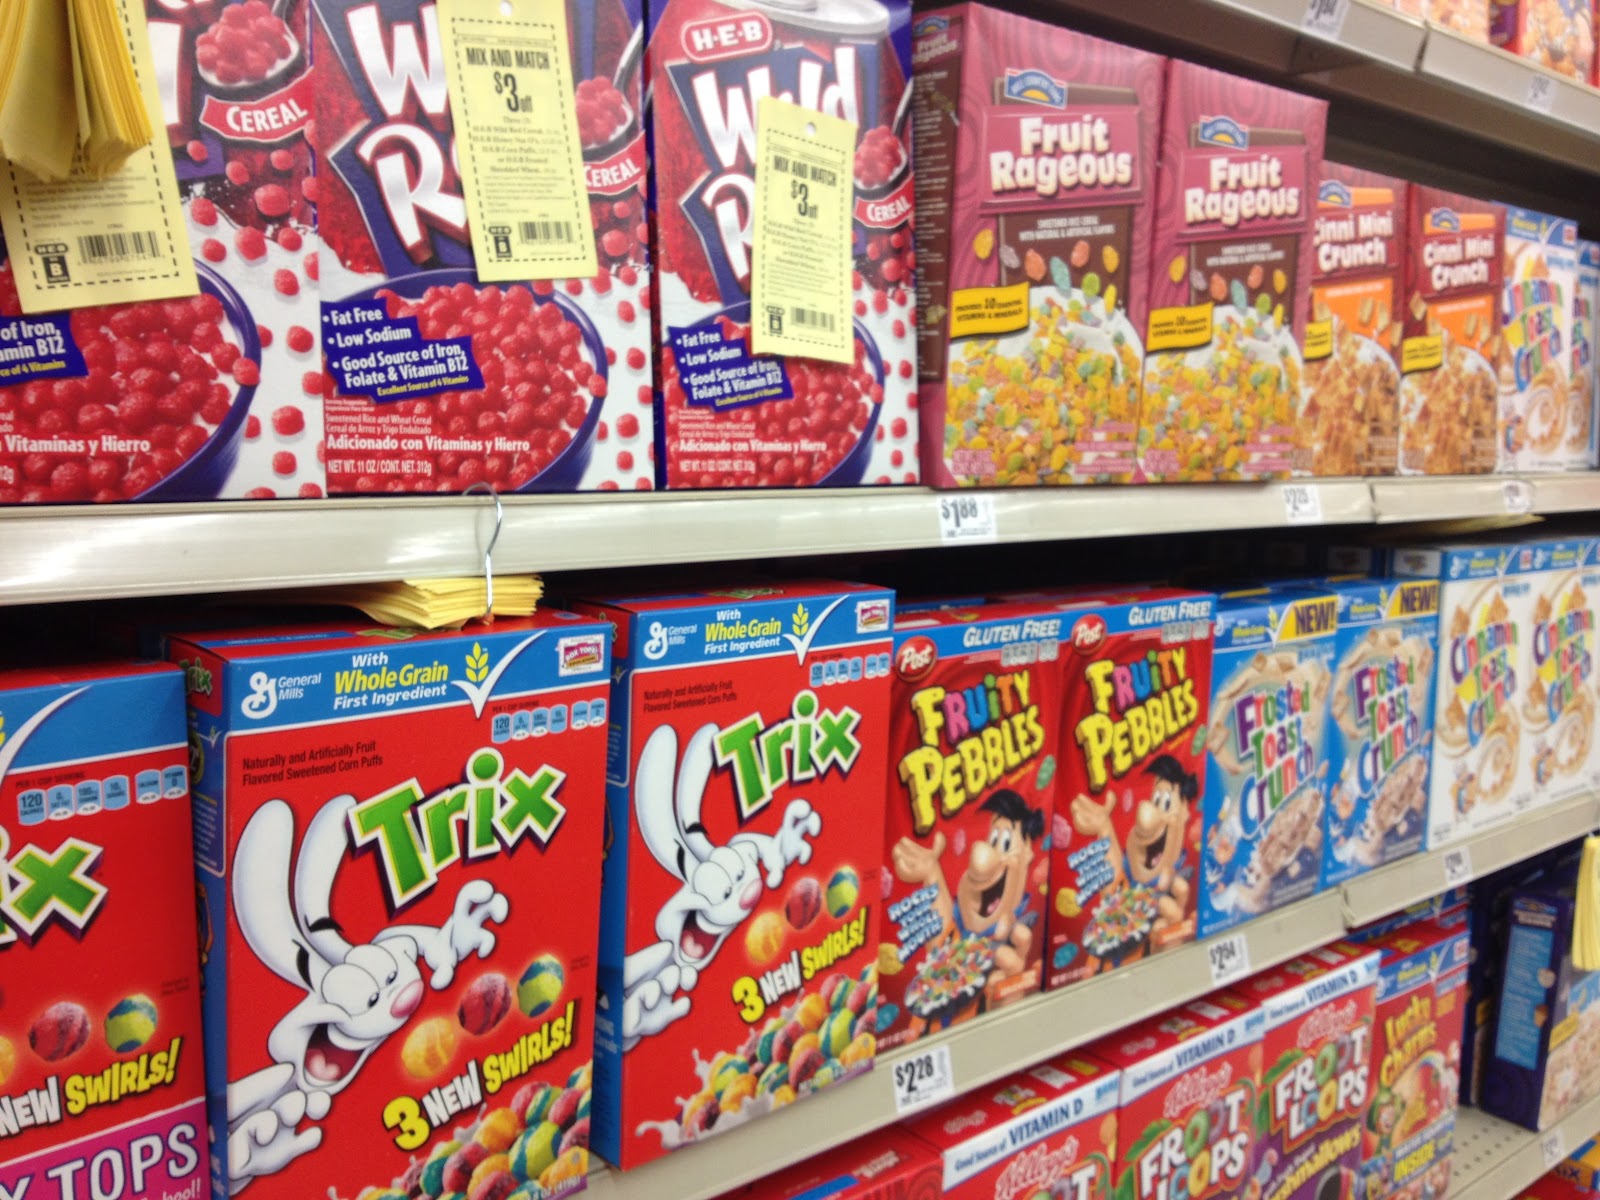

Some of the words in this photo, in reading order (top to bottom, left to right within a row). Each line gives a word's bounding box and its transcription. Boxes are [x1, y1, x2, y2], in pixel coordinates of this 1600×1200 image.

[466, 47, 488, 65] MIX
[490, 48, 512, 67] AND
[515, 49, 550, 70] MATCH
[493, 70, 520, 112] $3
[226, 98, 308, 133] CEREAL
[692, 46, 860, 168] Wld
[1019, 114, 1110, 156] Fruit
[583, 158, 641, 187] CEREAL
[774, 155, 788, 172] MIX
[792, 161, 807, 179] AND
[810, 165, 836, 187] MATCH
[989, 151, 1133, 196] Rageous
[1210, 153, 1282, 192] Fruit
[1184, 187, 1300, 226] Rageous
[1358, 210, 1394, 238] Mini
[1317, 238, 1387, 273] Crunch
[1423, 241, 1464, 268] Cinni
[1465, 234, 1496, 259] Mini
[1431, 258, 1489, 291] Crunch
[1, 322, 18, 341] of
[20, 321, 62, 338] Iron,
[331, 310, 352, 326] Fat
[353, 307, 383, 321] Free
[36, 336, 66, 357] B12
[336, 332, 364, 348] Low
[365, 325, 412, 344] Sodium
[682, 334, 699, 347] Fat
[698, 331, 721, 345] Free
[341, 352, 376, 371] Good
[377, 350, 420, 367] Source
[421, 344, 434, 360] of
[435, 343, 466, 359] Iron,
[686, 353, 707, 366] Low
[707, 346, 742, 362] Sodium
[344, 371, 386, 388] Folate
[387, 366, 398, 381] &
[399, 360, 447, 380] Vitamin
[447, 356, 469, 373] B12
[326, 413, 361, 424] Sweetened
[362, 413, 376, 424] Rice
[377, 414, 389, 424] and
[412, 415, 432, 425] Cereal
[5, 434, 85, 453] Vitaminas
[88, 439, 99, 457] y
[101, 435, 151, 453] Hierro
[327, 434, 398, 450] Adicionado
[401, 438, 423, 450] con
[425, 436, 483, 451] Vitaminas
[484, 439, 493, 454] y
[495, 436, 531, 451] Hierro
[680, 439, 732, 452] Adicionado
[732, 441, 749, 452] con
[751, 439, 793, 452] Vitaminas
[328, 460, 343, 473] NET
[416, 461, 432, 476] 312g
[1128, 603, 1175, 626] GLUTEN
[1176, 600, 1212, 619] FREE!
[1400, 583, 1438, 613] NEW!
[668, 624, 698, 636] General
[705, 621, 746, 642] Whole
[747, 617, 782, 637] Grain
[716, 609, 741, 621] With
[1293, 600, 1336, 636] NEW!
[668, 635, 686, 645] Mills
[704, 642, 727, 655] First
[729, 637, 781, 653] Ingredient
[963, 621, 1021, 648] GLUTEN
[1021, 617, 1062, 640] FREE!
[1074, 619, 1103, 647] Post
[352, 652, 389, 668] With
[899, 645, 933, 673] Post
[278, 672, 322, 688] General
[335, 665, 399, 695] Whole
[400, 661, 449, 686] Grain
[1085, 646, 1186, 714] FRUITY
[278, 687, 304, 701] Mills
[333, 692, 368, 711] First
[371, 683, 447, 706] Ingredient
[911, 669, 1030, 748] FRUITY
[495, 717, 510, 728] 120
[1234, 679, 1310, 758] Frosted
[1074, 678, 1199, 793] PEBBLES
[243, 754, 285, 770] Naturally
[289, 752, 306, 764] and
[308, 743, 354, 762] Artificially
[356, 740, 376, 754] Fruit
[243, 769, 284, 786] Flavored
[286, 761, 336, 780] Sweetened
[338, 757, 359, 771] Corn
[360, 754, 384, 768] Puffs
[712, 689, 862, 821] Trix
[898, 705, 1045, 837] PEBBLES
[21, 793, 43, 808] 120
[347, 747, 568, 910] Trix
[732, 975, 766, 1024] 3
[758, 949, 803, 1006] NEW
[802, 905, 868, 981] SWIRLS!
[1305, 974, 1349, 1003] VITAMIN
[1350, 970, 1358, 984] D
[1176, 1033, 1226, 1069] VITAMIN
[1227, 1028, 1236, 1044] D
[0, 1075, 62, 1138] NEW
[65, 1037, 182, 1115] SWIRLS!
[382, 1095, 431, 1150] 3
[421, 1059, 483, 1128] NEW
[482, 1000, 576, 1094] SWIRLS!
[1275, 1026, 1368, 1120] FROOT
[1289, 1065, 1369, 1140] LOOPS
[1008, 1105, 1069, 1147] VITAMIN
[1073, 1098, 1084, 1116] D
[1140, 1088, 1246, 1198] FROOT
[47, 1122, 198, 1200] TOPS
